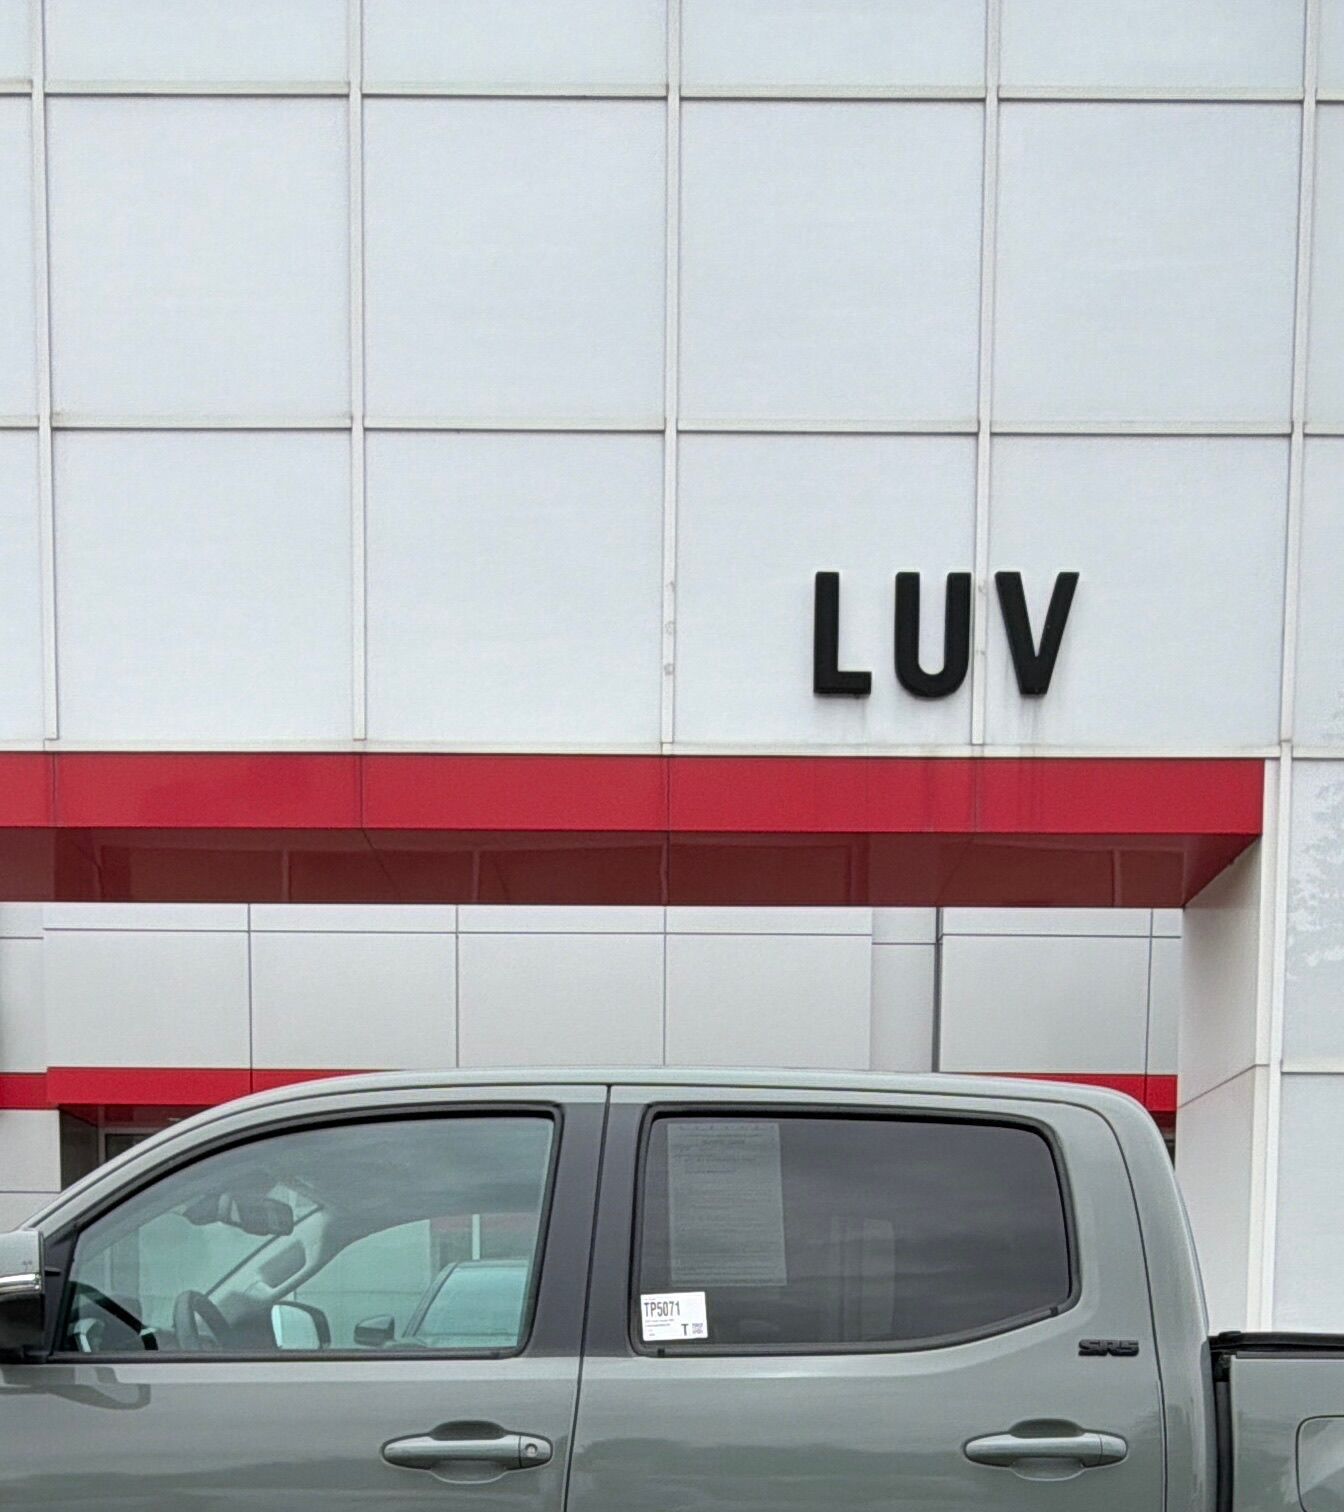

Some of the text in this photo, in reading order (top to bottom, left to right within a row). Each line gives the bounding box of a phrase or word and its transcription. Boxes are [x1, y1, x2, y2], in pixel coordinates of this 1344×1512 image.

[813, 571, 1080, 698] LUV
[643, 1300, 681, 1318] TP5071
[680, 1323, 689, 1337] T
[1078, 1339, 1139, 1357] SR5
